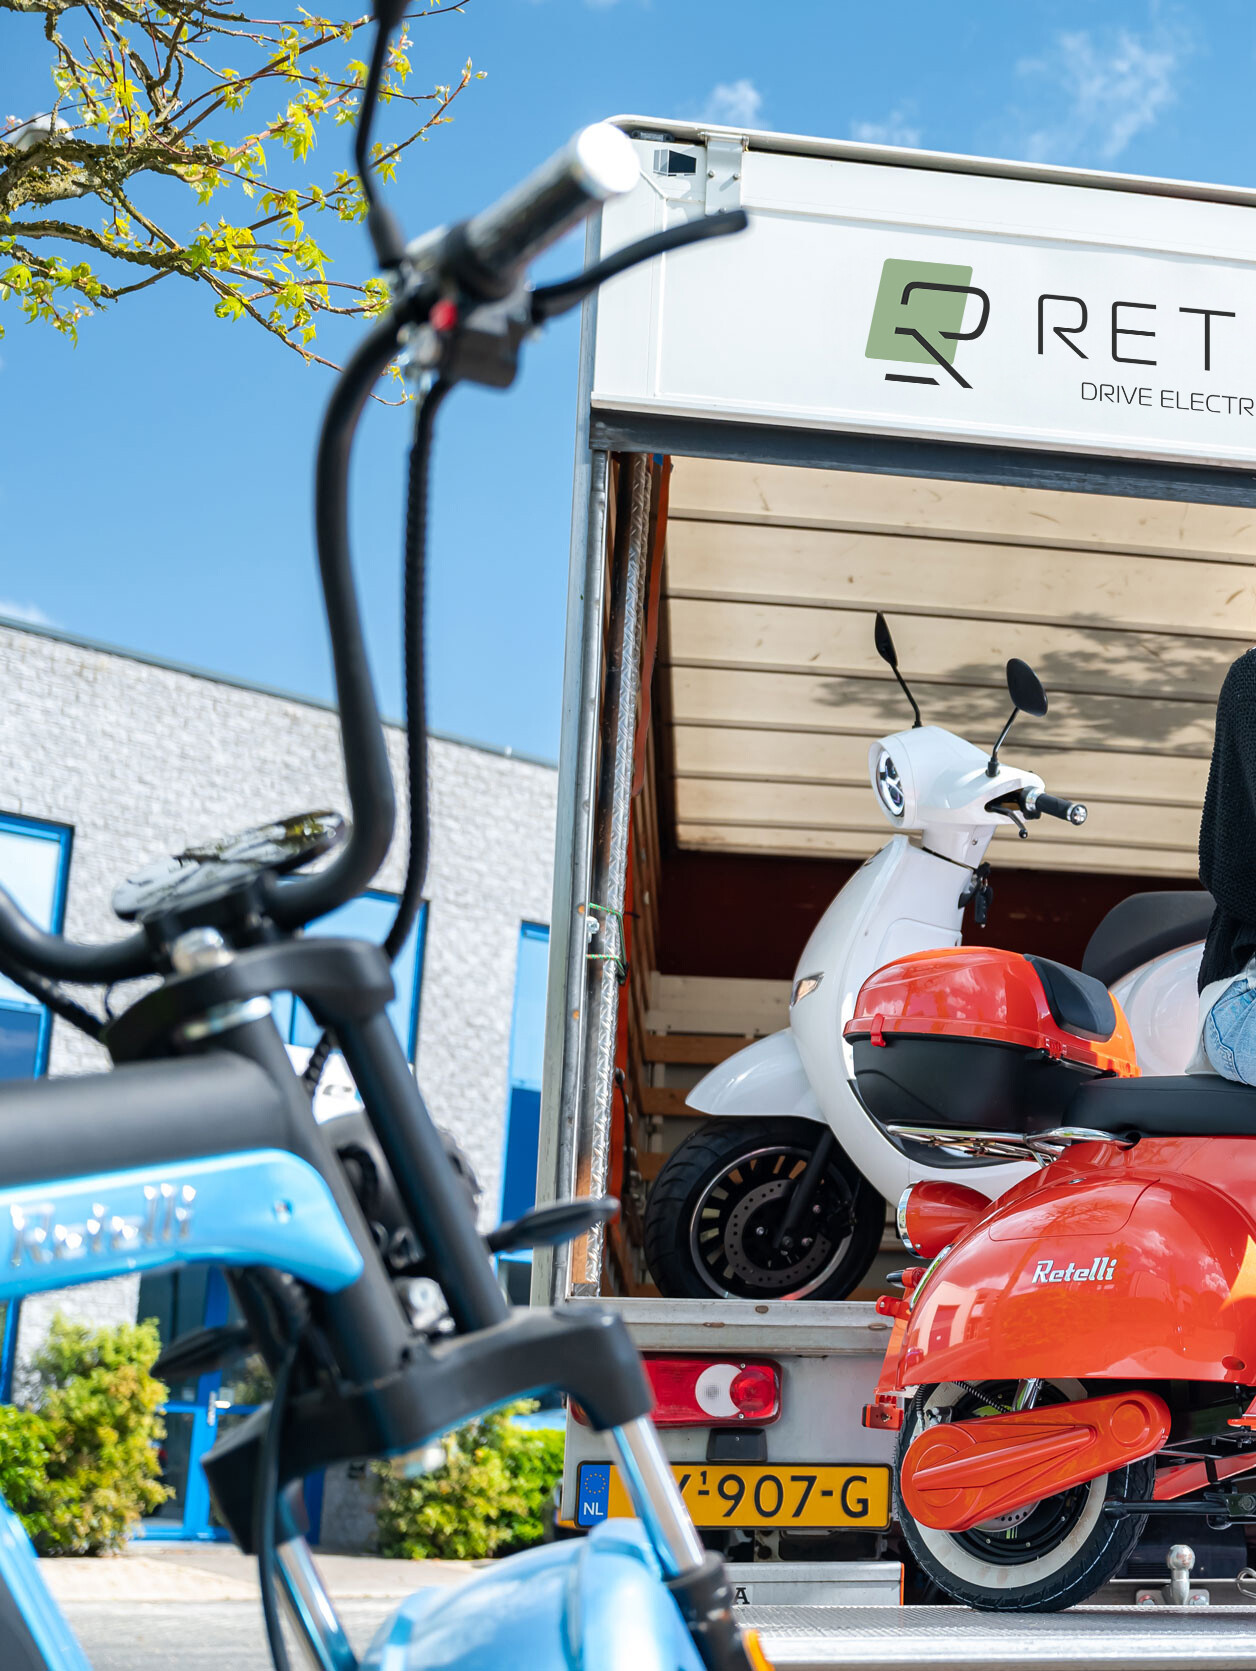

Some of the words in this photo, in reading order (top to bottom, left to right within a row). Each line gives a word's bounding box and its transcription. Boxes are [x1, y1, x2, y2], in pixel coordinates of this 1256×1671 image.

[1081, 381, 1153, 407] DRIVE
[1032, 1256, 1118, 1284] Retelli
[583, 1502, 604, 1516] NL
